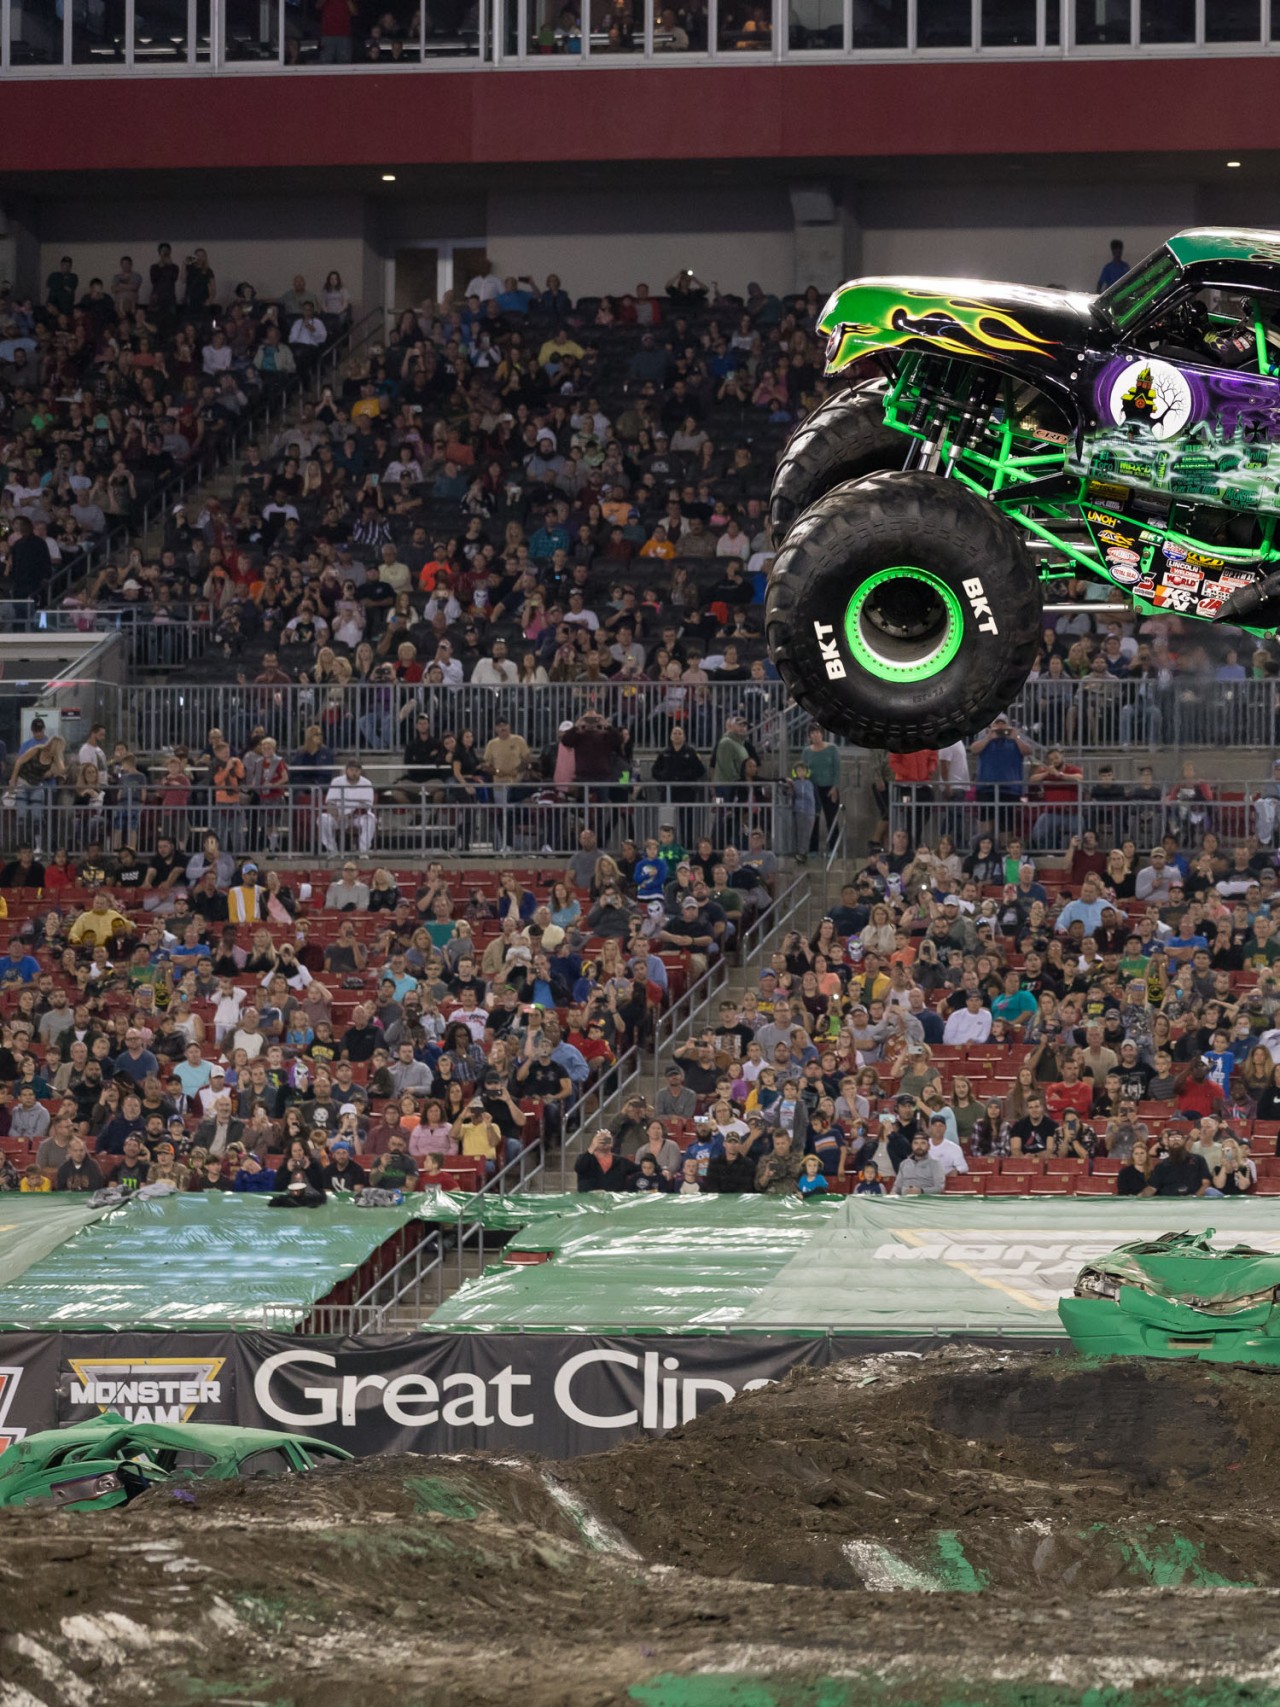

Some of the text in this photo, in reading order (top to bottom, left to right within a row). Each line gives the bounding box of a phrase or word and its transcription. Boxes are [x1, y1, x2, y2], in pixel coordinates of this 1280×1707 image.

[1087, 510, 1117, 527] UNOH
[1168, 559, 1199, 573] LINCOLN
[1167, 574, 1197, 588] WORLD
[962, 577, 999, 635] BKT
[814, 620, 847, 680] BKT
[70, 1381, 222, 1405] MONSTER
[254, 1350, 535, 1428] Great
